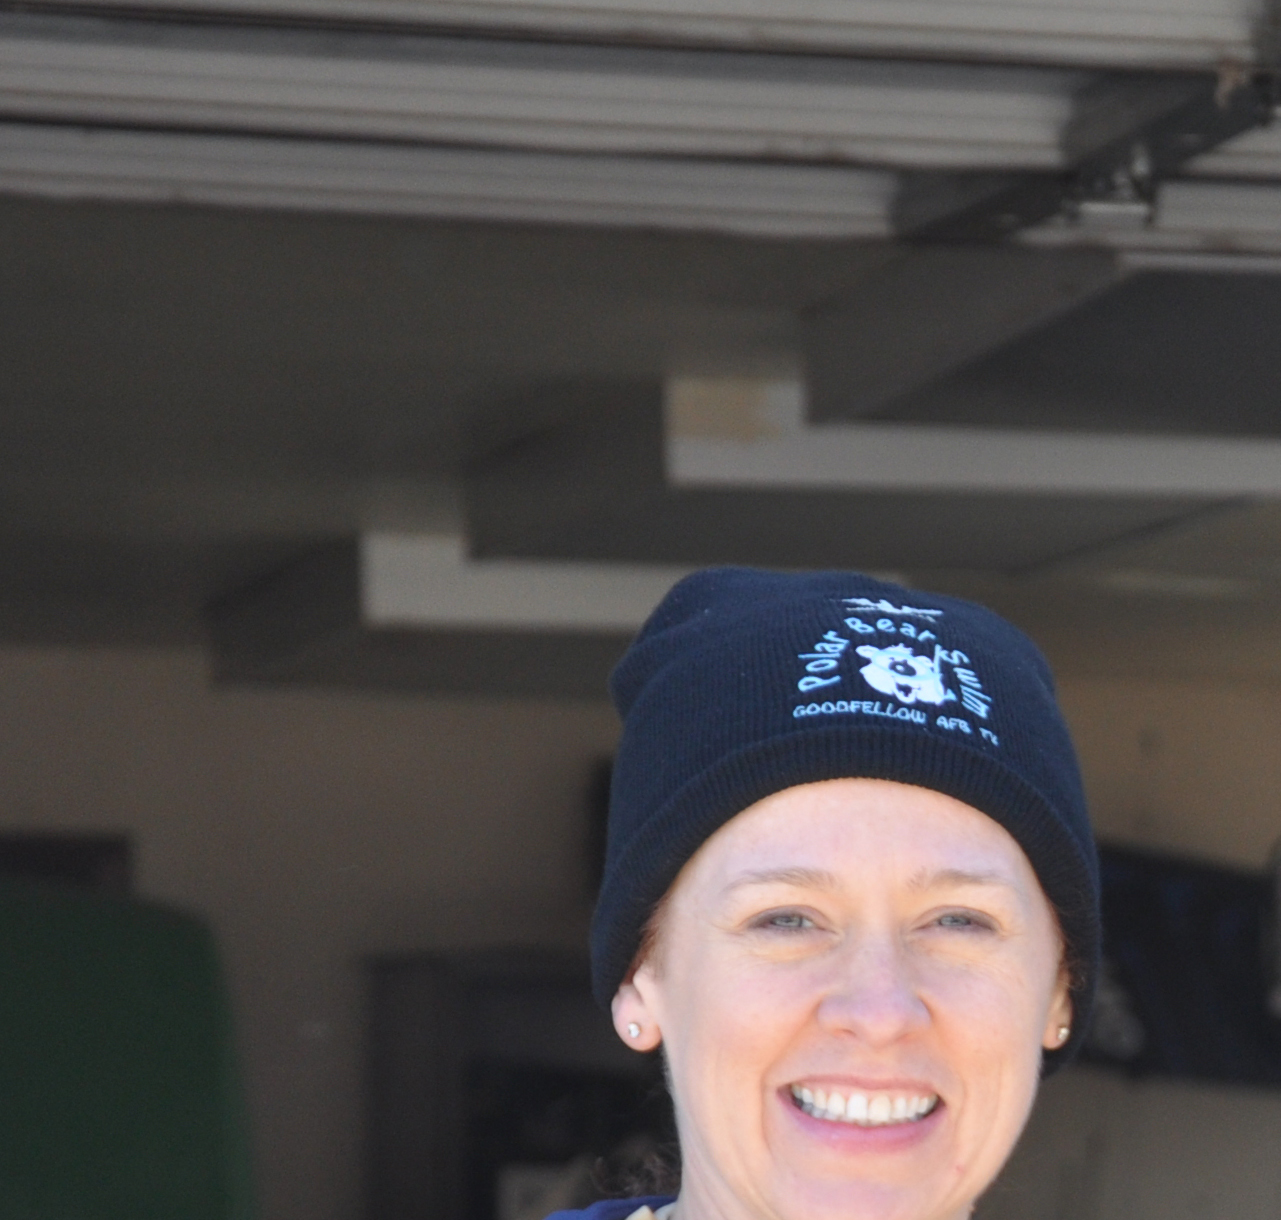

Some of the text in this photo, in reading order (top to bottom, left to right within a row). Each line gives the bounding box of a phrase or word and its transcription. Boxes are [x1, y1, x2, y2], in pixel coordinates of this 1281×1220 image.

[797, 616, 993, 720] Polar Bear Swim
[793, 700, 926, 726] GOODFELLOW
[936, 715, 972, 735] AFB
